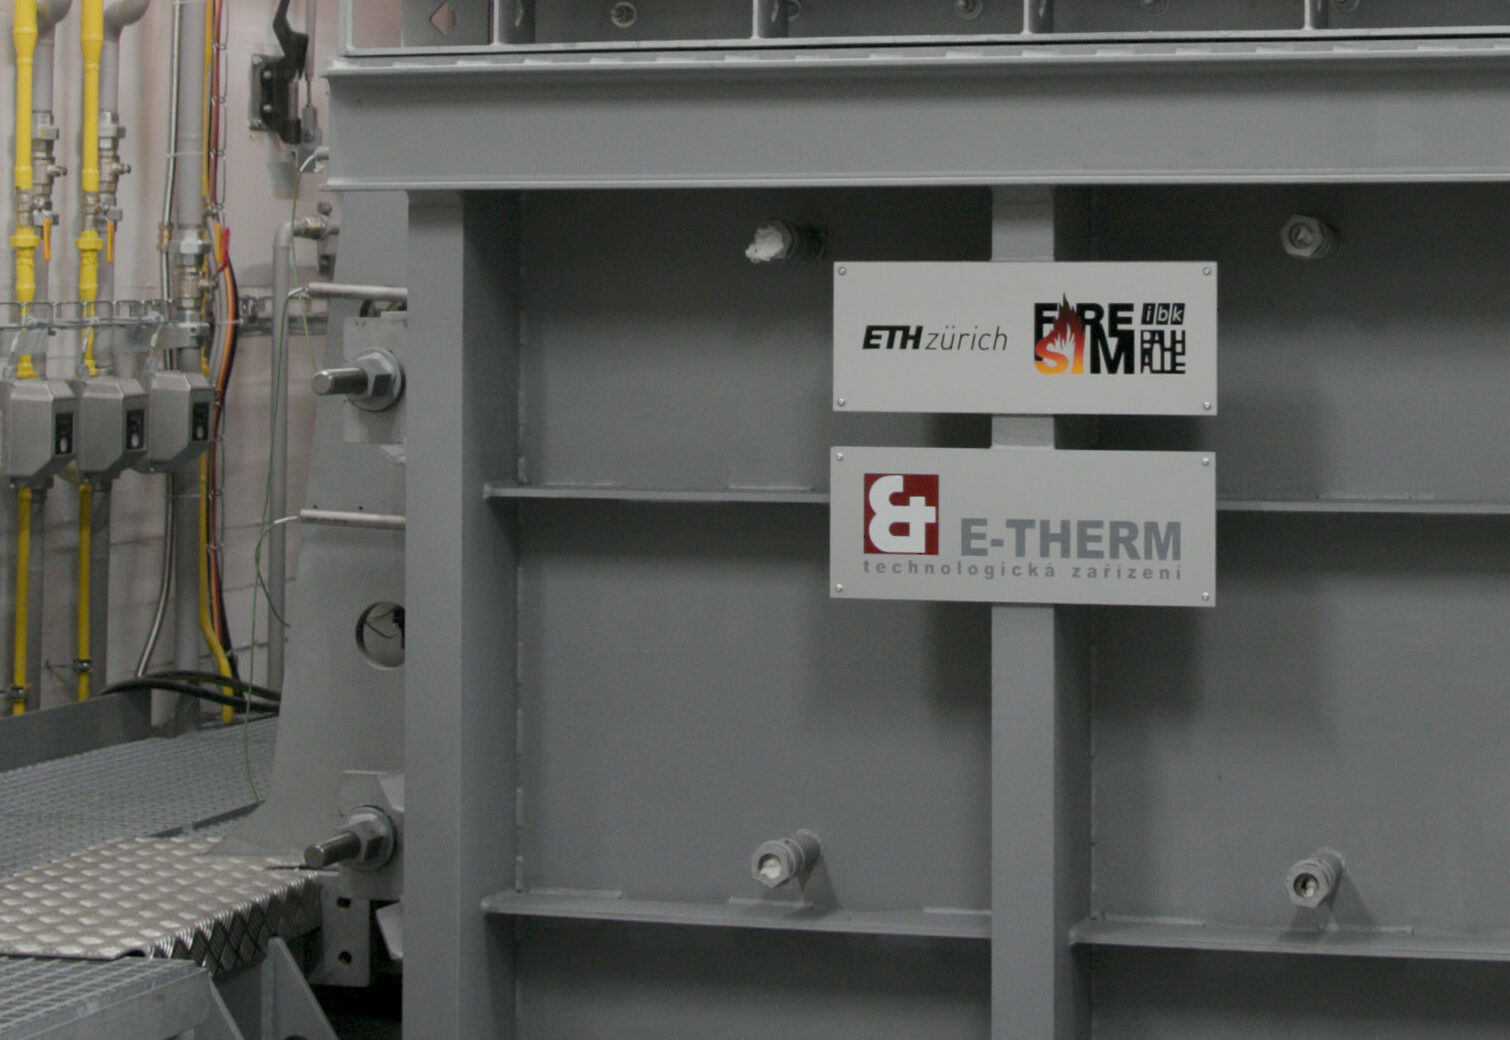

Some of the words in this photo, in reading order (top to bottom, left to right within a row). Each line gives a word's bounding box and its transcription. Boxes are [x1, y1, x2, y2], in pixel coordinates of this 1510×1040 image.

[1141, 303, 1186, 325] ibk
[961, 518, 1181, 560] E-THERM
[864, 560, 1056, 579] technologická
